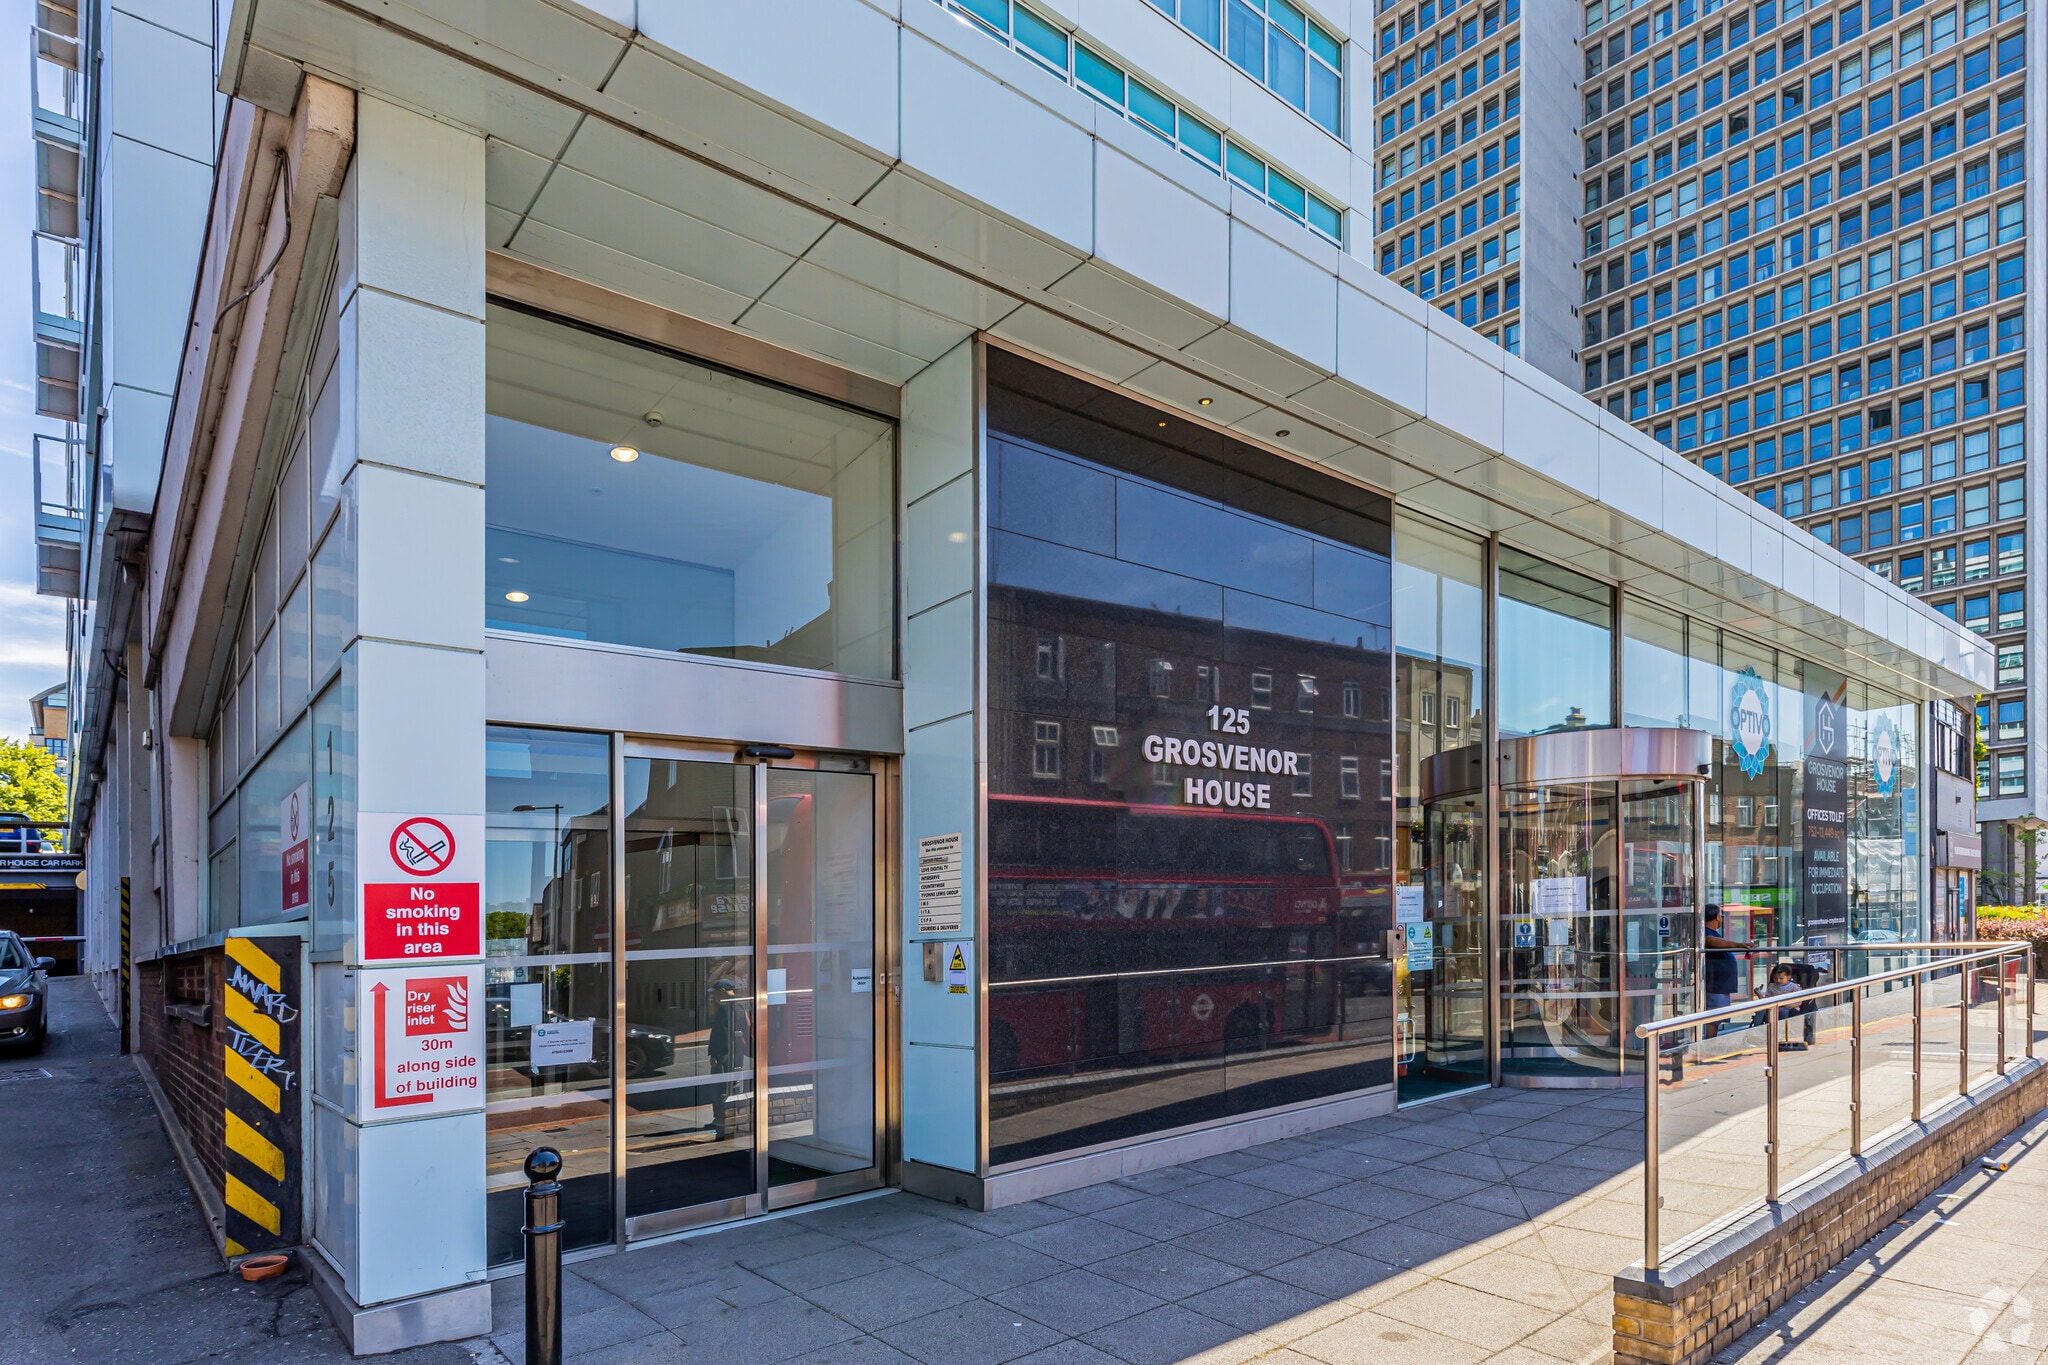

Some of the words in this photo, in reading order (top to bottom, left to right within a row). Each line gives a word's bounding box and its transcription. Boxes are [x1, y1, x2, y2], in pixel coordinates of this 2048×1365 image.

[1206, 705, 1250, 735] 125
[1730, 706, 1771, 737] OPTIVO
[1142, 734, 1298, 776] GROSVENOR
[1808, 761, 1844, 780] GROSVENOR
[1184, 777, 1271, 809] HOUSE
[1816, 778, 1836, 793] HOUSE
[1807, 808, 1829, 822] OFFICES
[1829, 811, 1836, 822] TO
[1836, 811, 1845, 823] LET
[922, 838, 945, 847] GROSVENOR
[1813, 850, 1839, 862] AVAILABLE
[1808, 867, 1819, 878] FOR
[1819, 867, 1845, 879] IMMEDIATE
[410, 886, 435, 901] No
[1811, 883, 1842, 895] OCCUPATION
[385, 904, 460, 921] smoking
[396, 922, 413, 937] in
[417, 922, 450, 936] this
[404, 942, 443, 955] area
[407, 990, 431, 1002] Dry
[407, 1003, 437, 1014] riser
[407, 1014, 435, 1026] inlet
[421, 1039, 453, 1051] 30m
[397, 1060, 440, 1073] along
[445, 1055, 477, 1068] side
[396, 1081, 412, 1093] of
[416, 1076, 477, 1091] building
